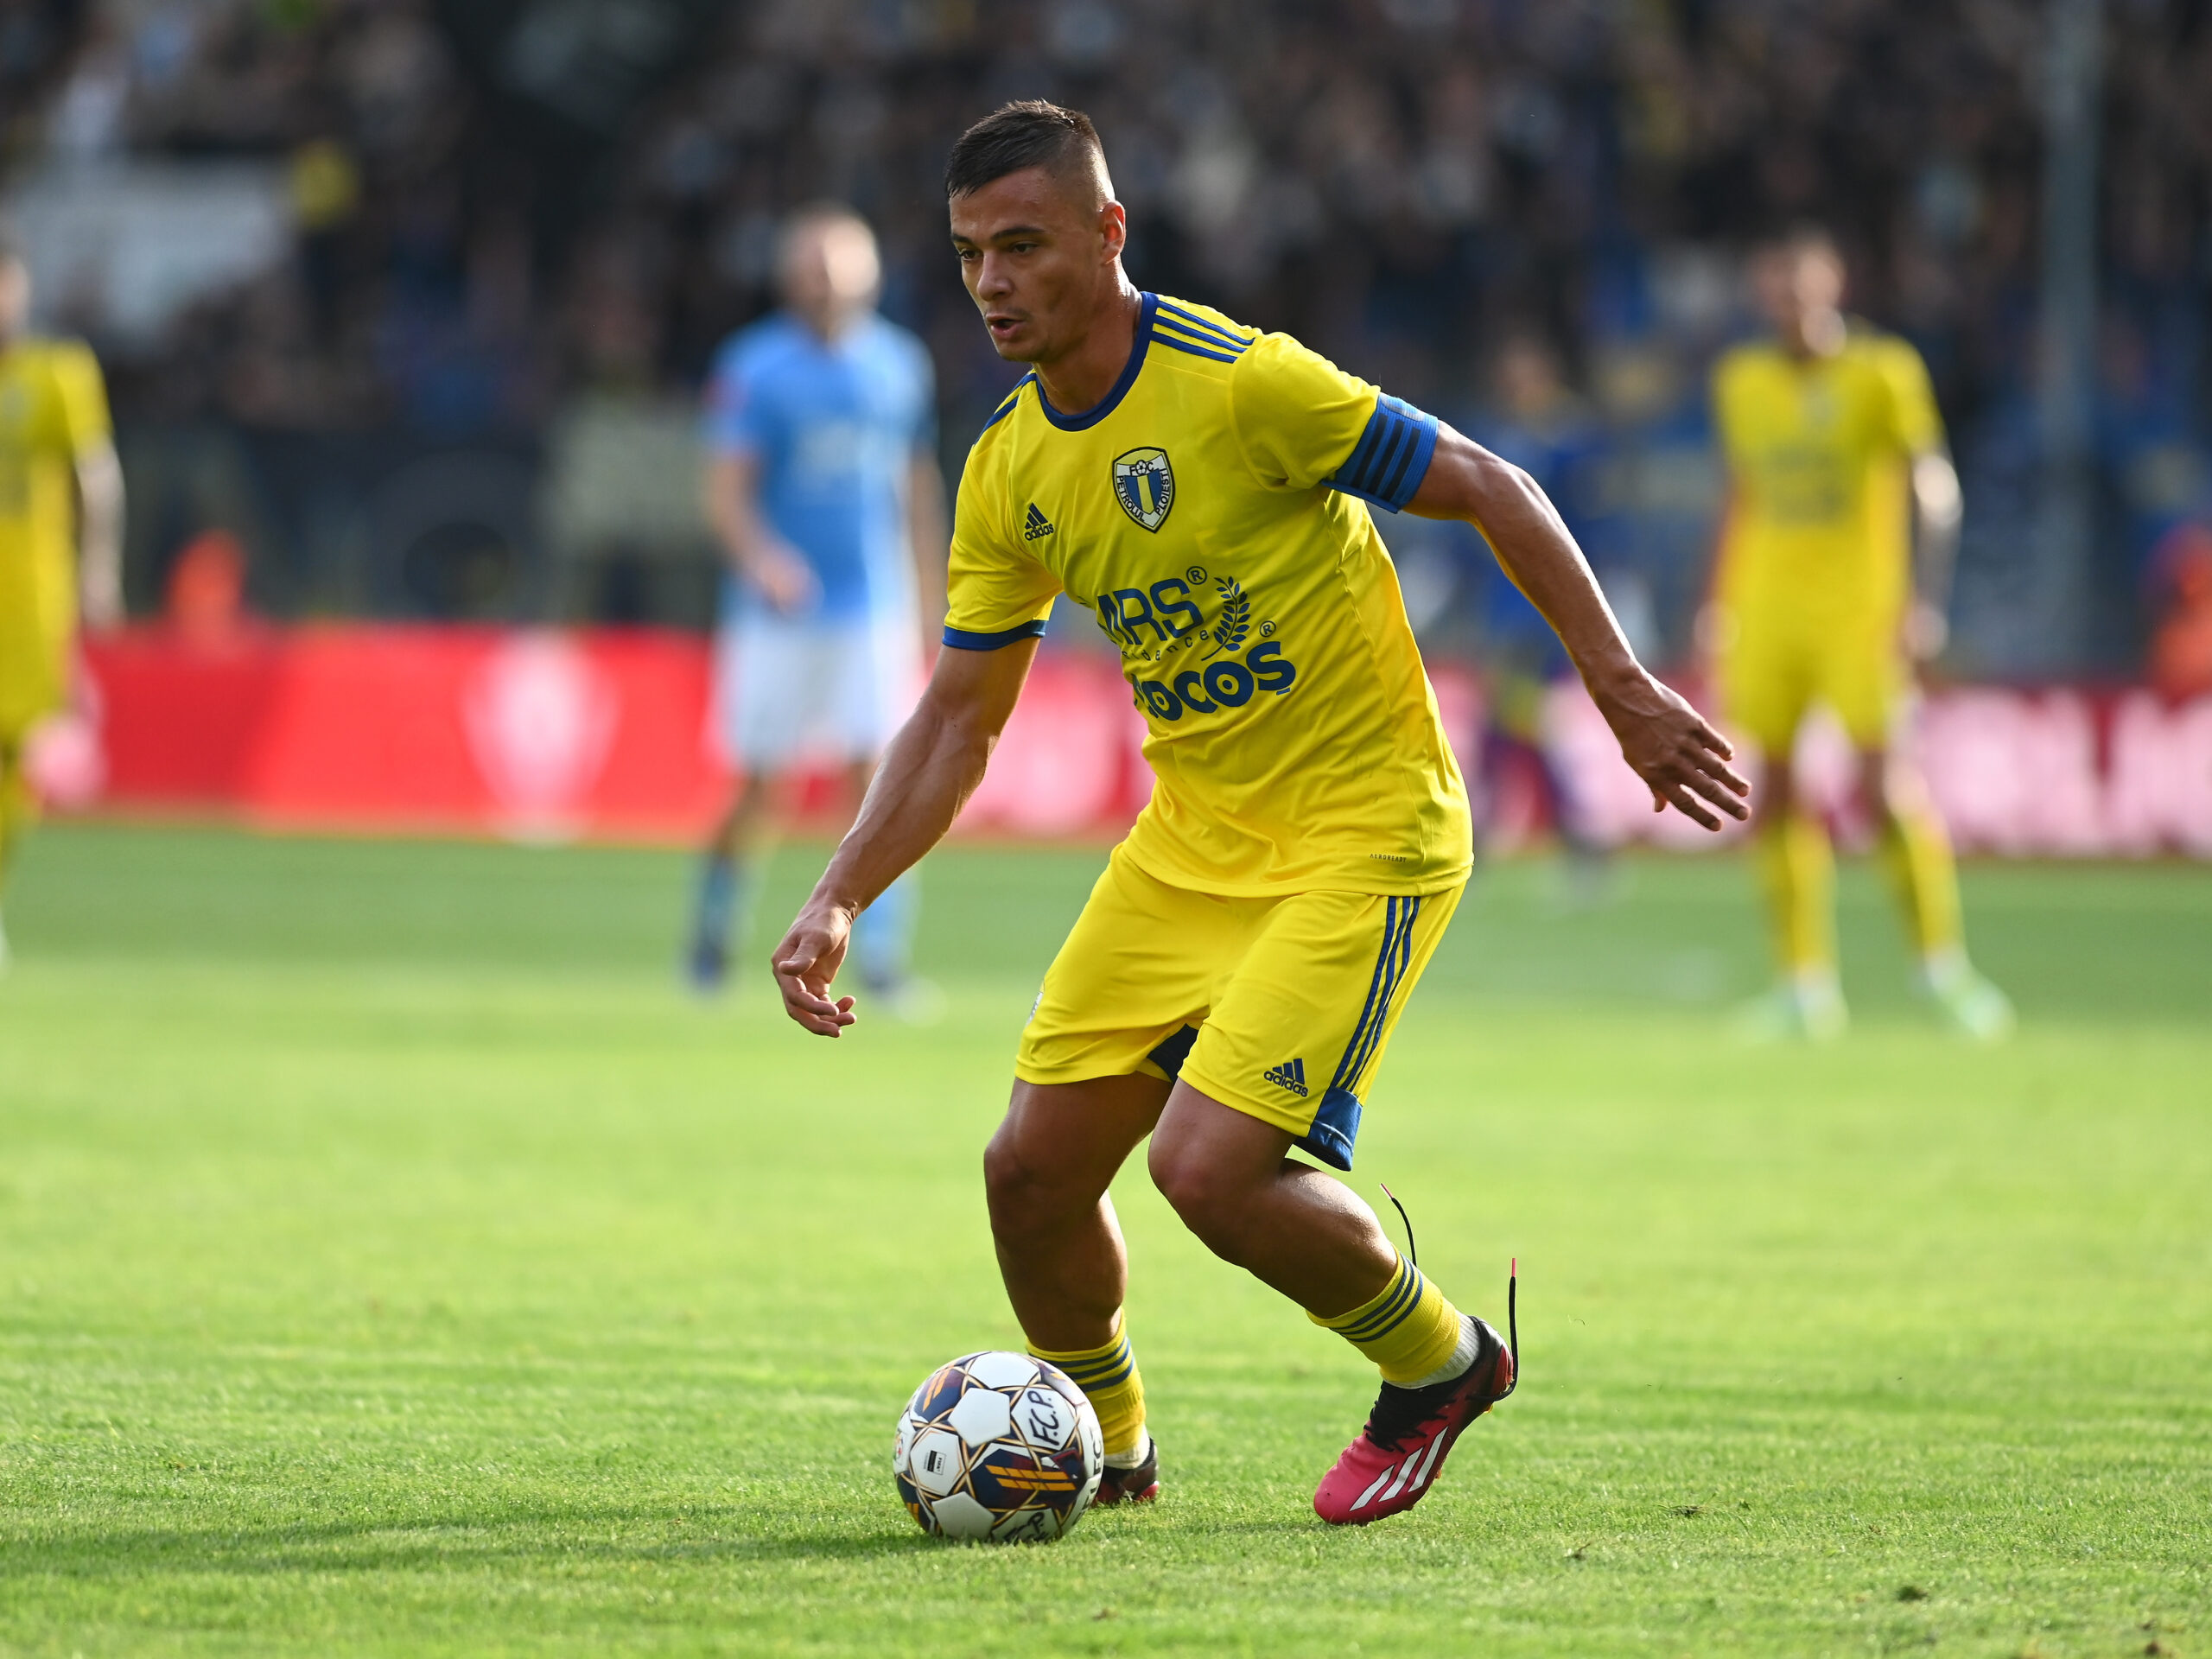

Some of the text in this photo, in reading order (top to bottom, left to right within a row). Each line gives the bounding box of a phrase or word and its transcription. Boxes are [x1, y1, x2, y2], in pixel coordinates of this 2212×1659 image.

[1116, 475, 1145, 523] PETROLUL
[1024, 523, 1054, 541] adidas
[1370, 853, 1407, 863] AEROREADY
[1263, 1071, 1309, 1097] adidas
